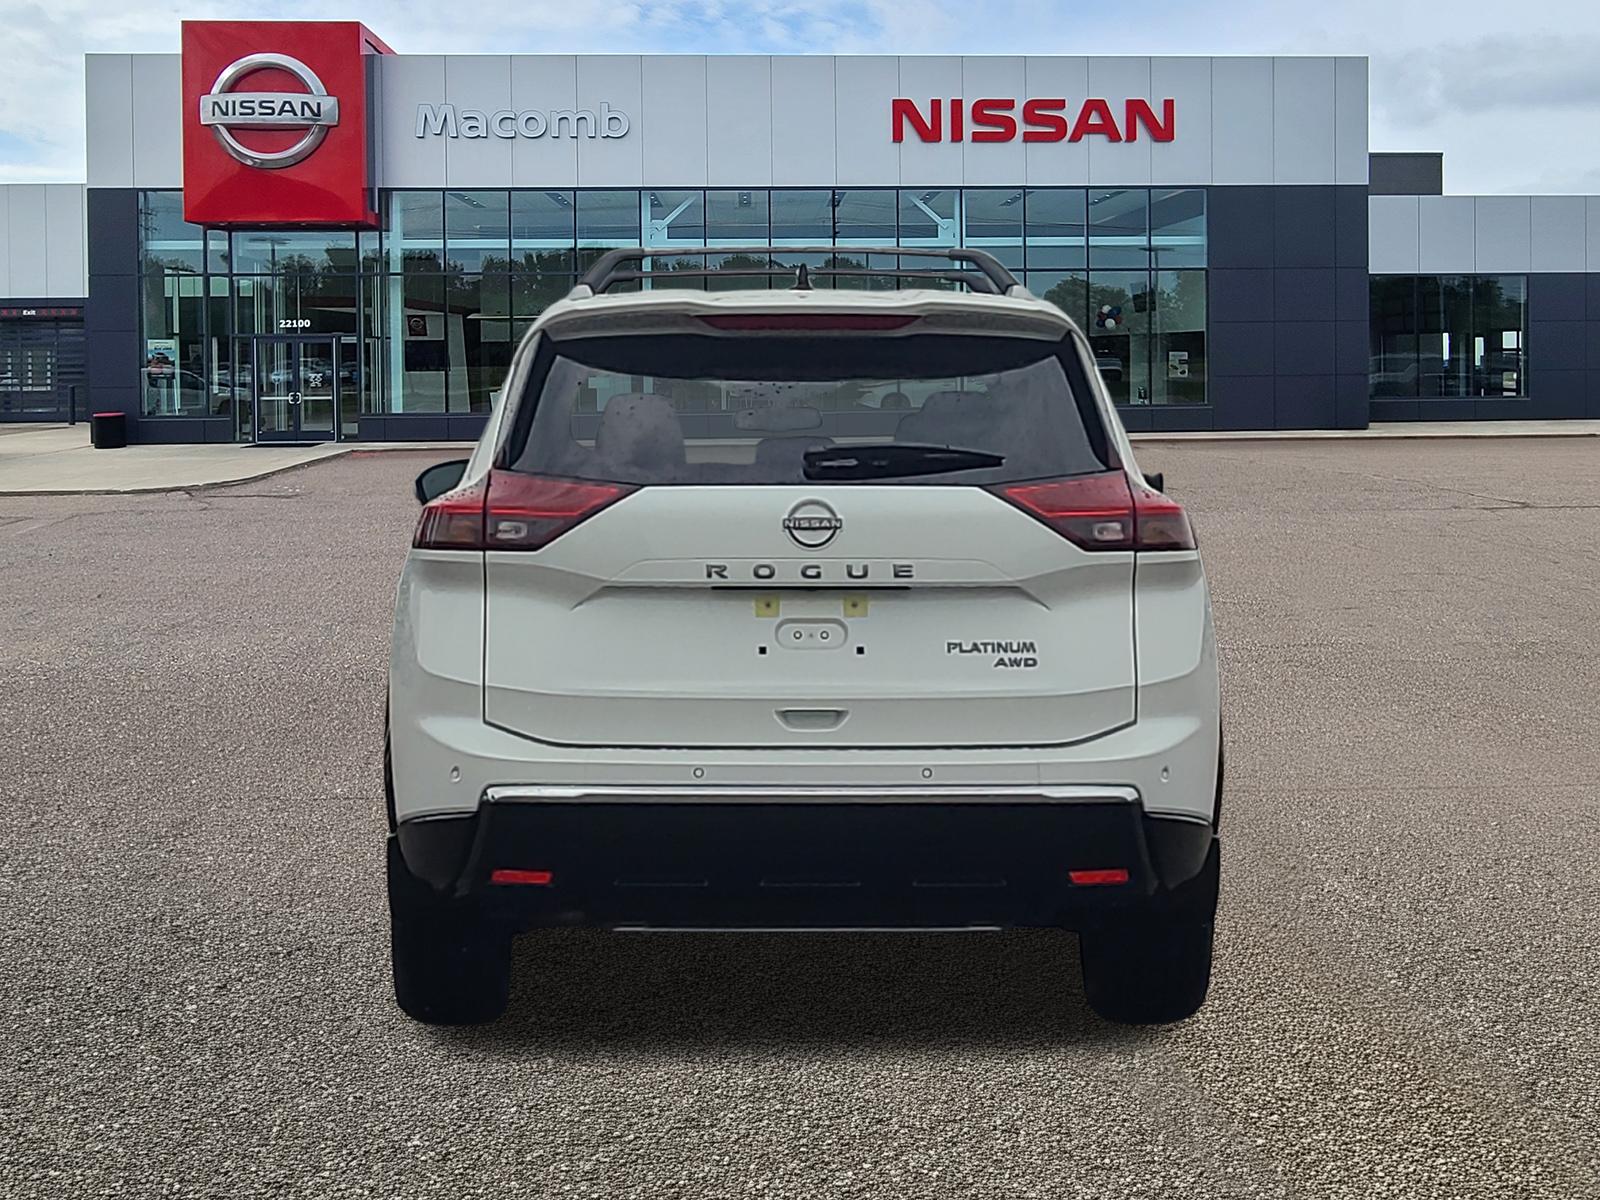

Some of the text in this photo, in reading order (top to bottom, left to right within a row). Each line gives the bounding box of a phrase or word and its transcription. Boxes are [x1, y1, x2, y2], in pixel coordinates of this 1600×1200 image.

[211, 100, 322, 118] NISSAN
[415, 102, 630, 139] Macomb
[892, 98, 1176, 143] NISSAN
[279, 319, 311, 328] 22100
[784, 518, 841, 529] NISSAN
[705, 563, 915, 579] ROGUE
[946, 641, 1037, 654] PLATINUM
[993, 657, 1038, 668] AWD
